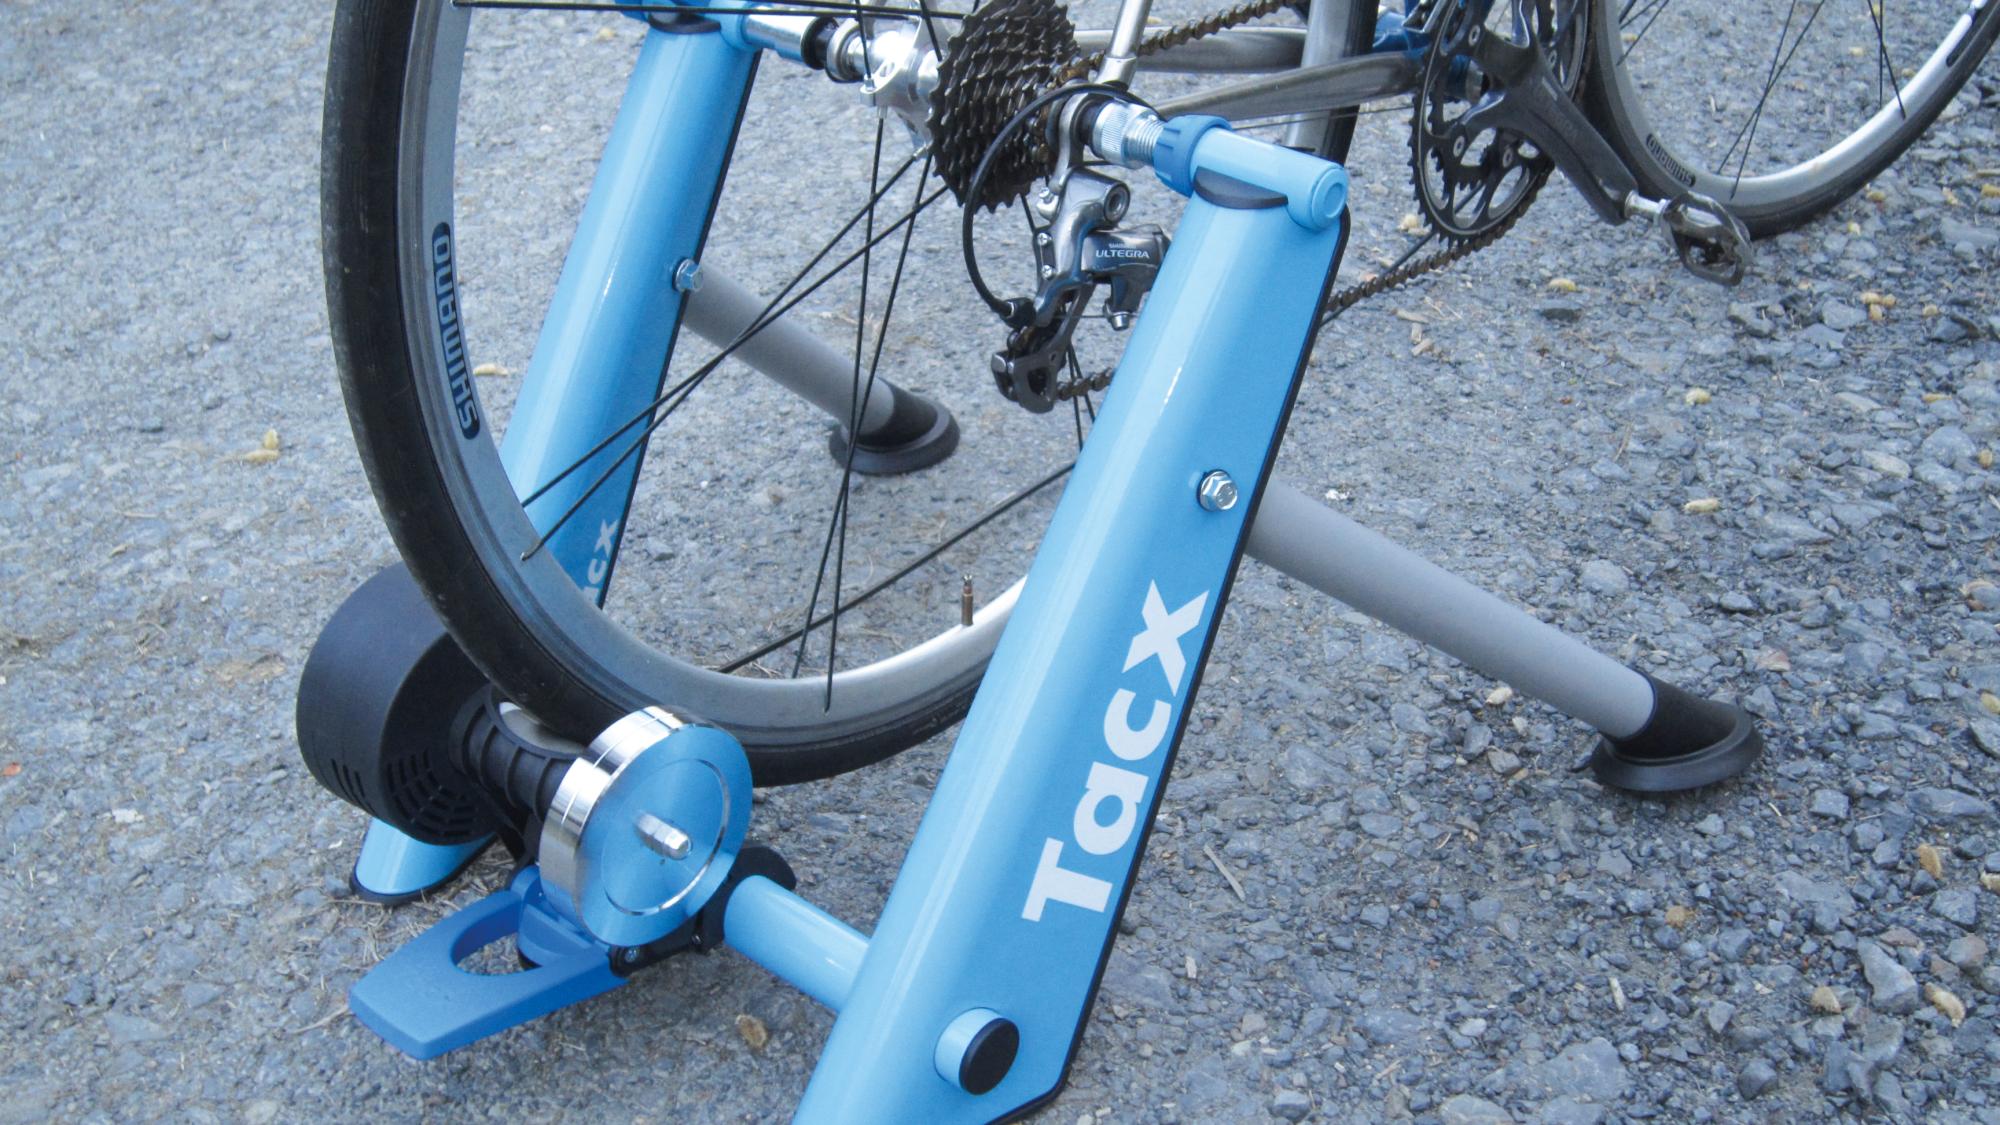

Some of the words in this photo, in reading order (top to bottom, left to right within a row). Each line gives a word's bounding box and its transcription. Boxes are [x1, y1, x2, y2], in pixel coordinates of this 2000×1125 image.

[433, 234, 478, 430] SHIMANO
[1096, 249, 1150, 259] ULTEGRA
[1021, 579, 1210, 922] Tacx
